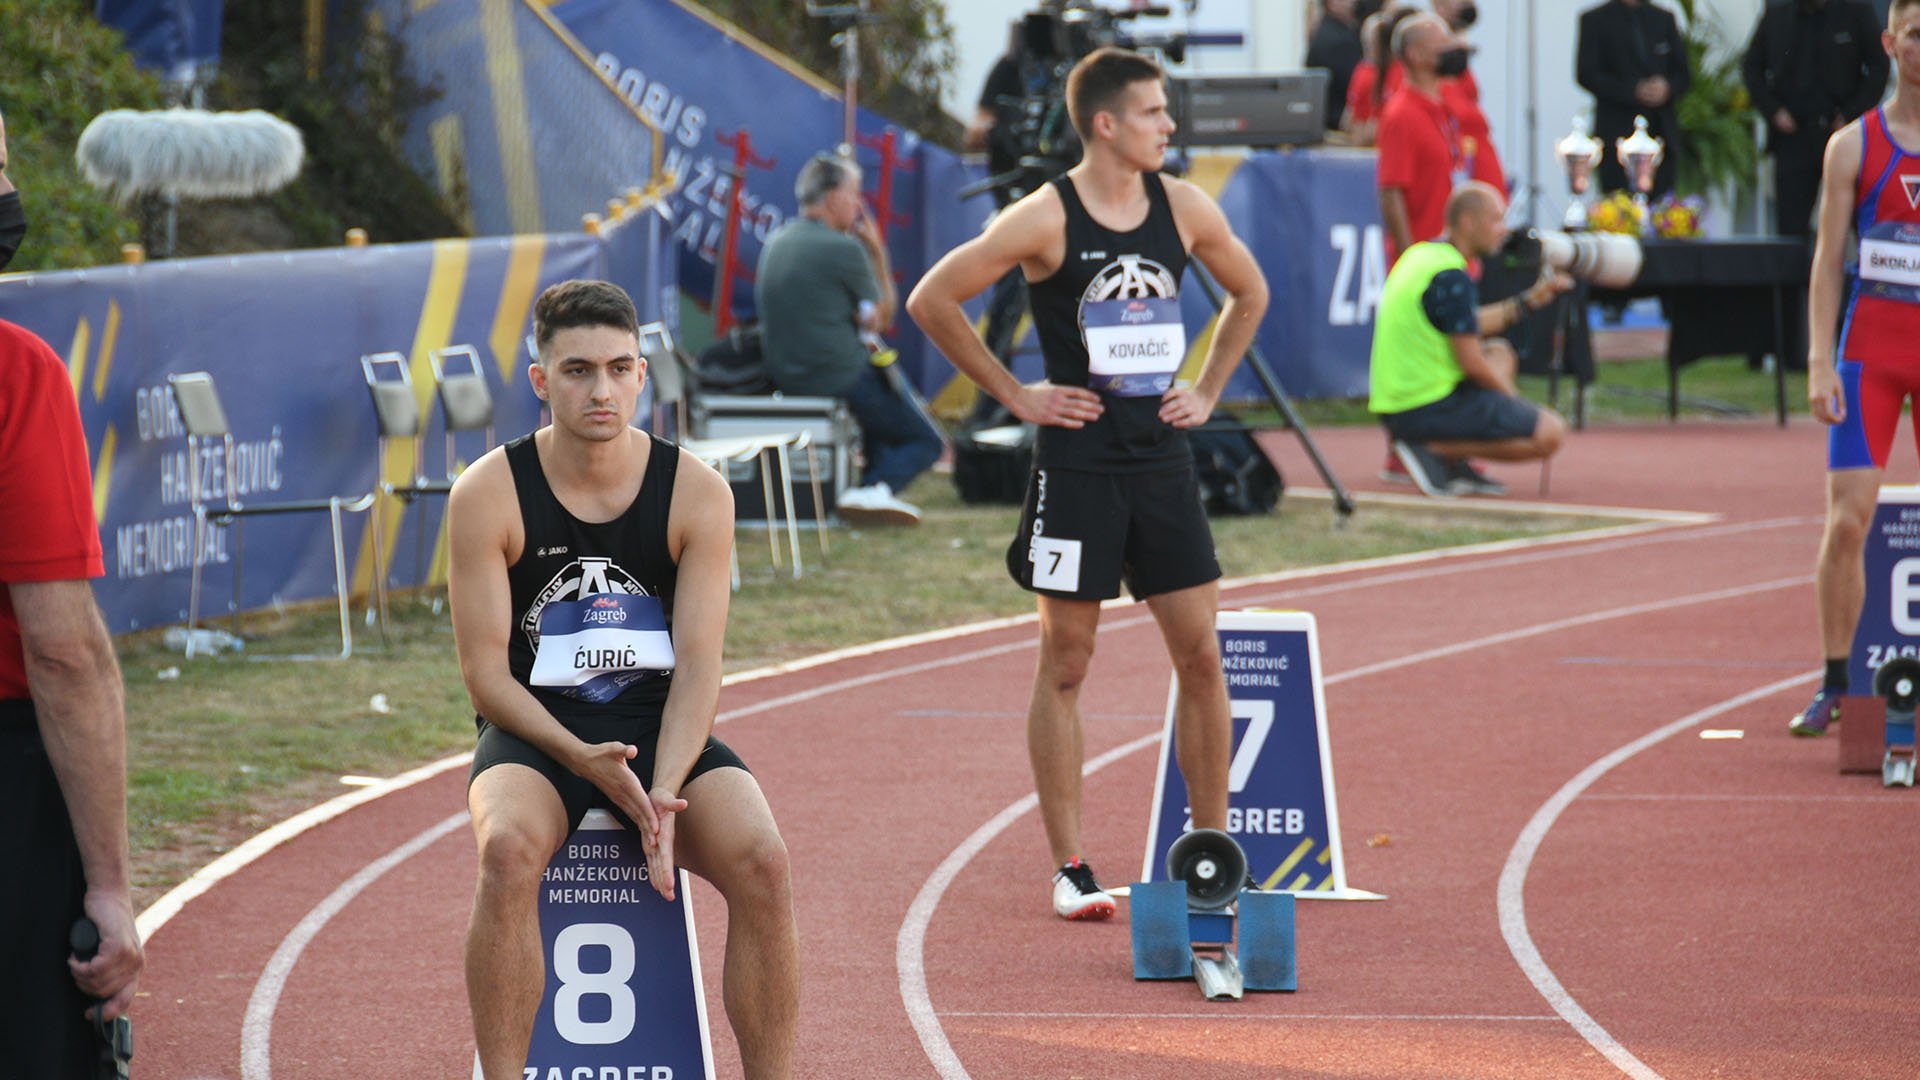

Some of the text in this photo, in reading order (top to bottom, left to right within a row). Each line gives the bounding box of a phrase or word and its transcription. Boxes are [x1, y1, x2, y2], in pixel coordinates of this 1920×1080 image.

[1328, 223, 1388, 325] ZA
[1048, 551, 1062, 576] 7
[582, 607, 627, 624] Zagreb
[1225, 640, 1267, 653] BORIS
[574, 645, 636, 669] ĆURIĆ
[1222, 655, 1288, 670] NŽEKOVIĆ
[1223, 674, 1281, 687] EMORIAL
[1228, 699, 1275, 793] 7
[1183, 808, 1304, 834] ZGREB
[568, 845, 620, 859] BORIS
[549, 889, 640, 904] MEMORIAL
[554, 922, 636, 1045] 8
